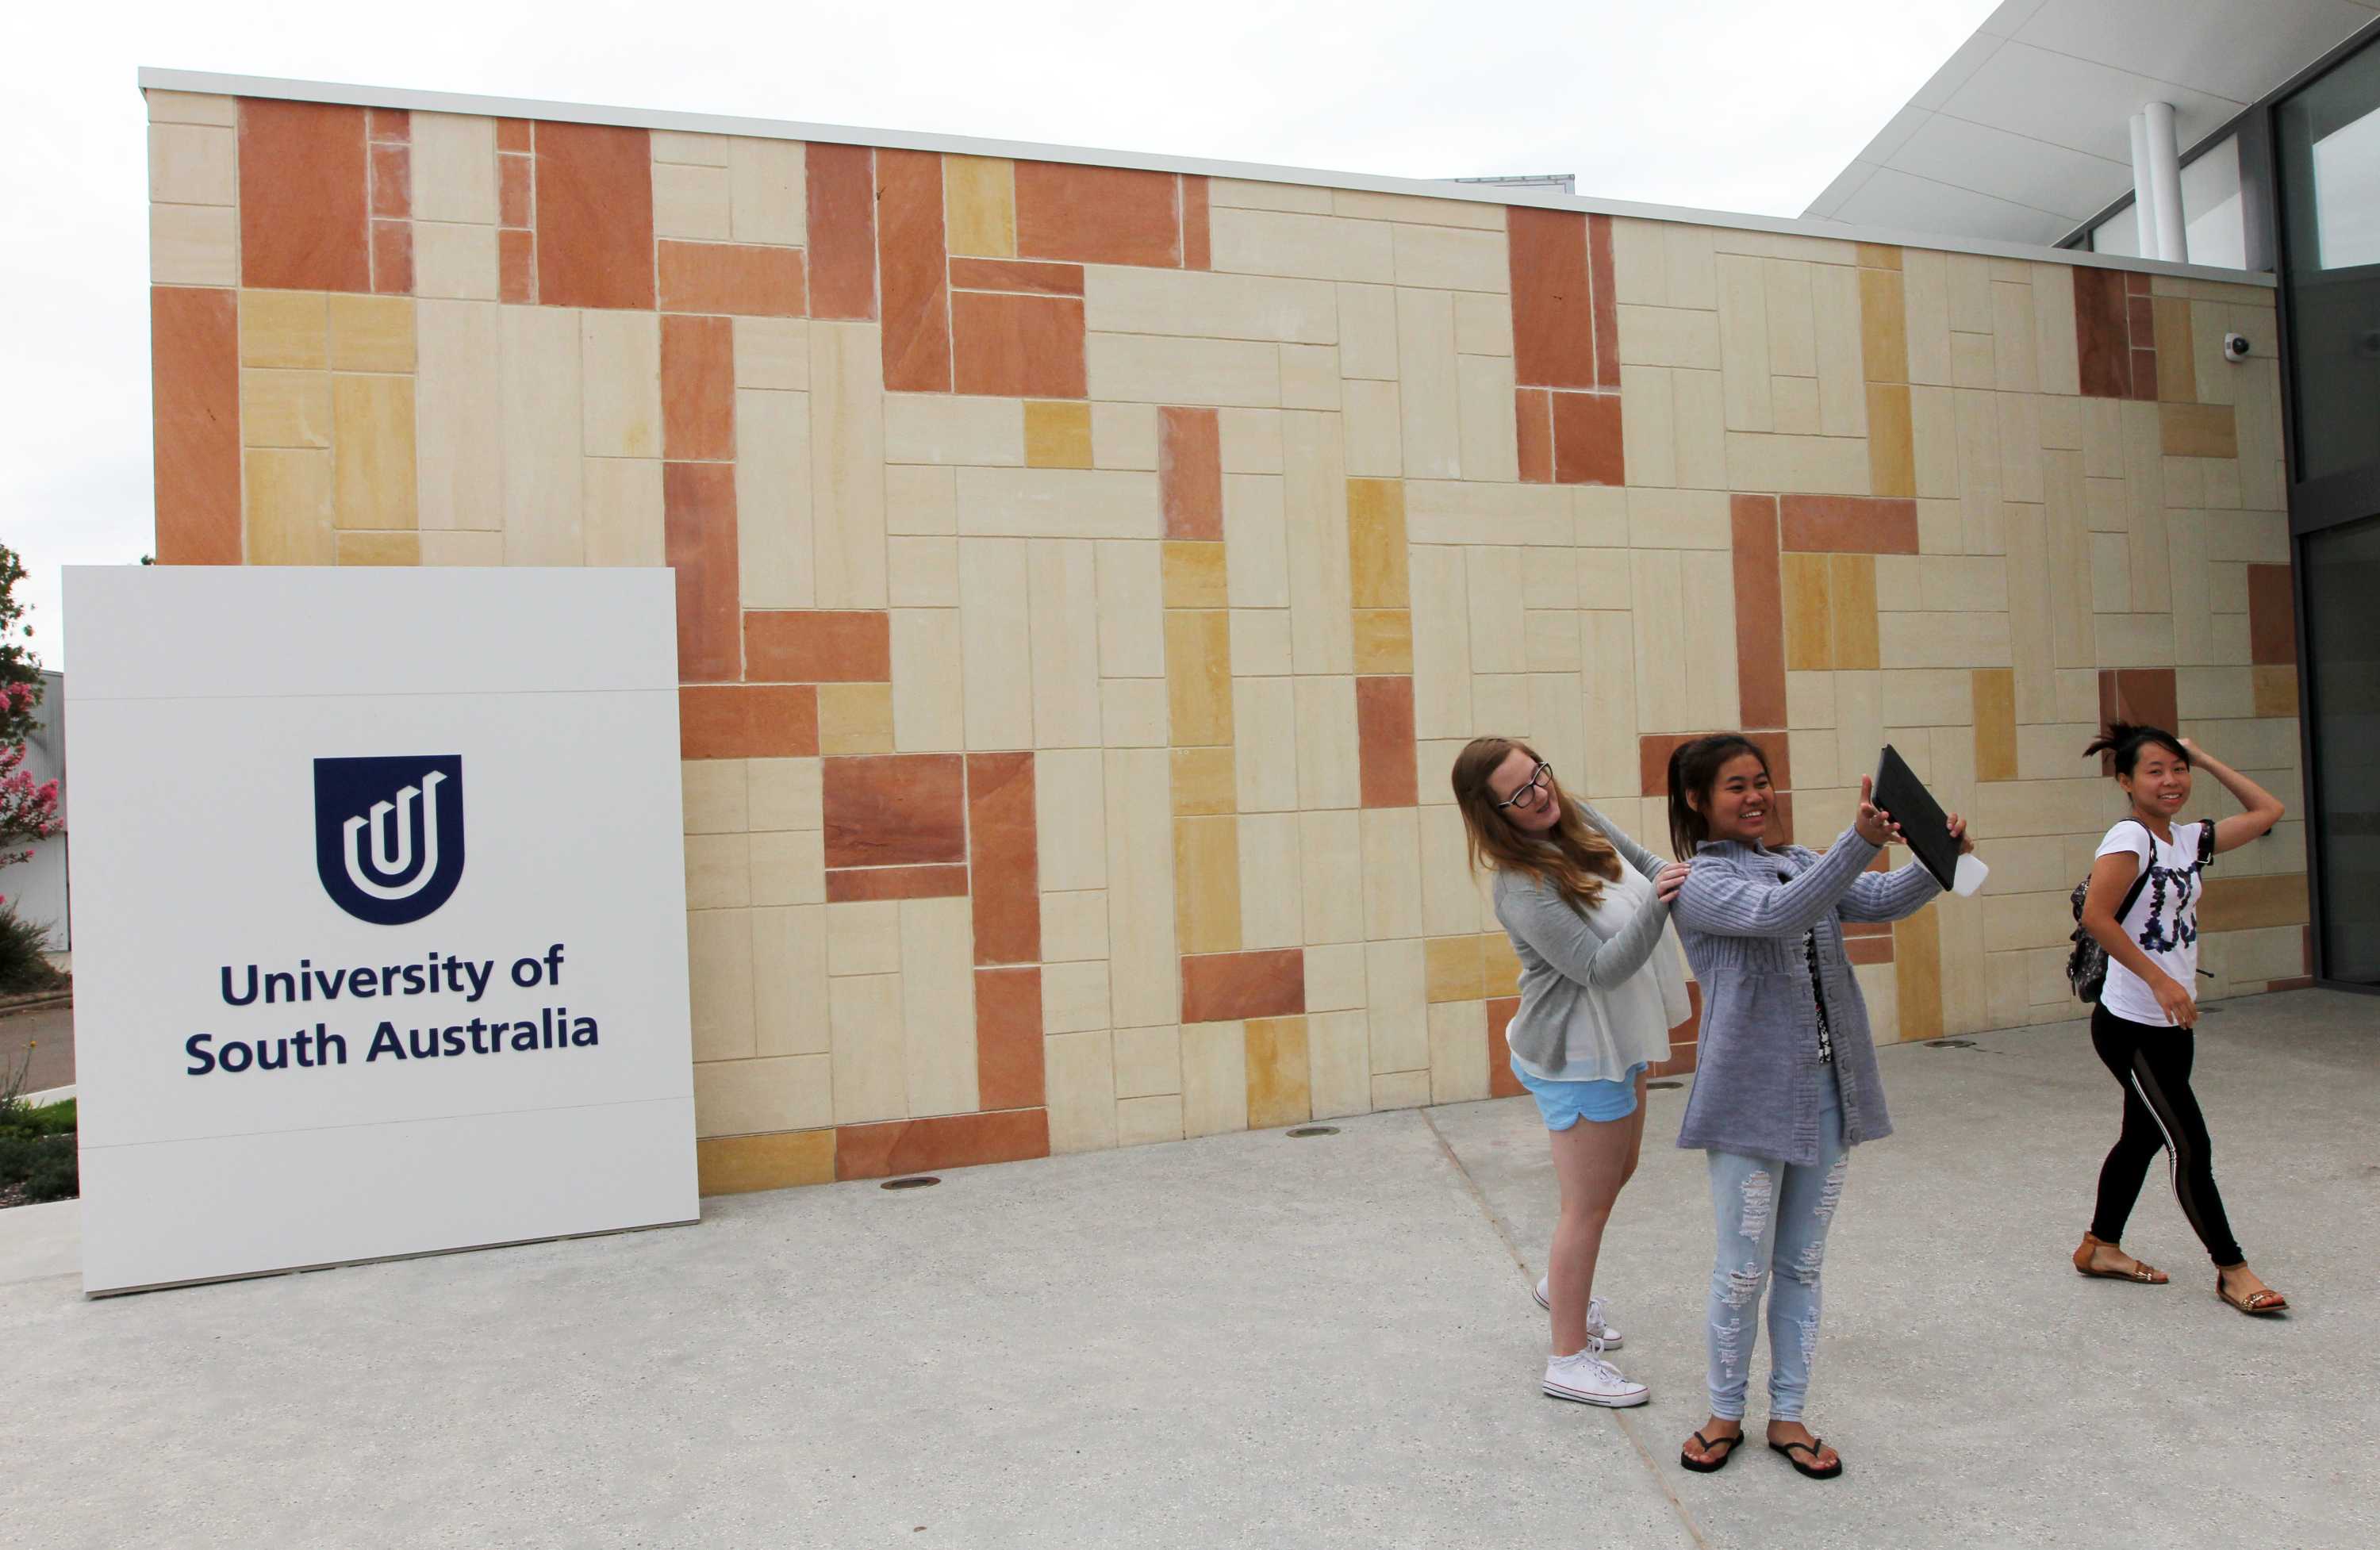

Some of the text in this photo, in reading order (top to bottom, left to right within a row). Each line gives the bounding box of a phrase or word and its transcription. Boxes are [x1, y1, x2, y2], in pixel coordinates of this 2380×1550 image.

[221, 943, 564, 1006] University of
[185, 1007, 599, 1076] South Australia
